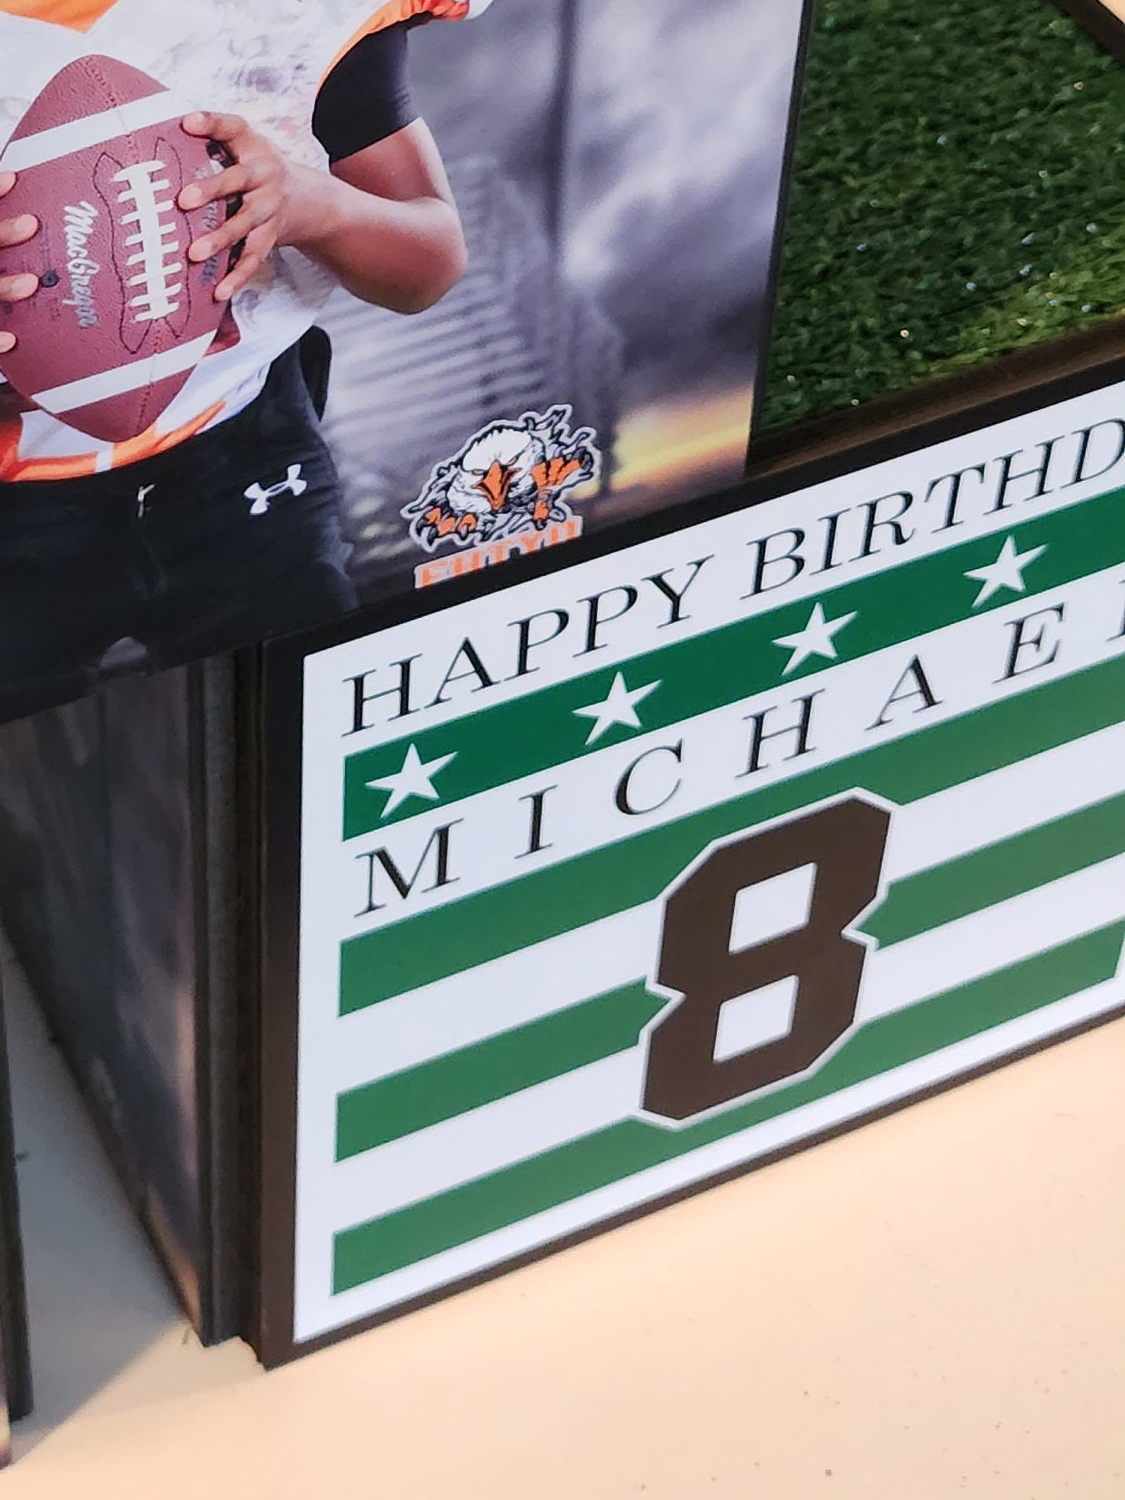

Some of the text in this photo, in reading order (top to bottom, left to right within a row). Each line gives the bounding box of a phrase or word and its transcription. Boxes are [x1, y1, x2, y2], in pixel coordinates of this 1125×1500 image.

[62, 200, 100, 330] MacGregor
[341, 553, 715, 738] HAPPY
[353, 579, 1125, 918] MICHAE
[640, 790, 893, 1125] 8
